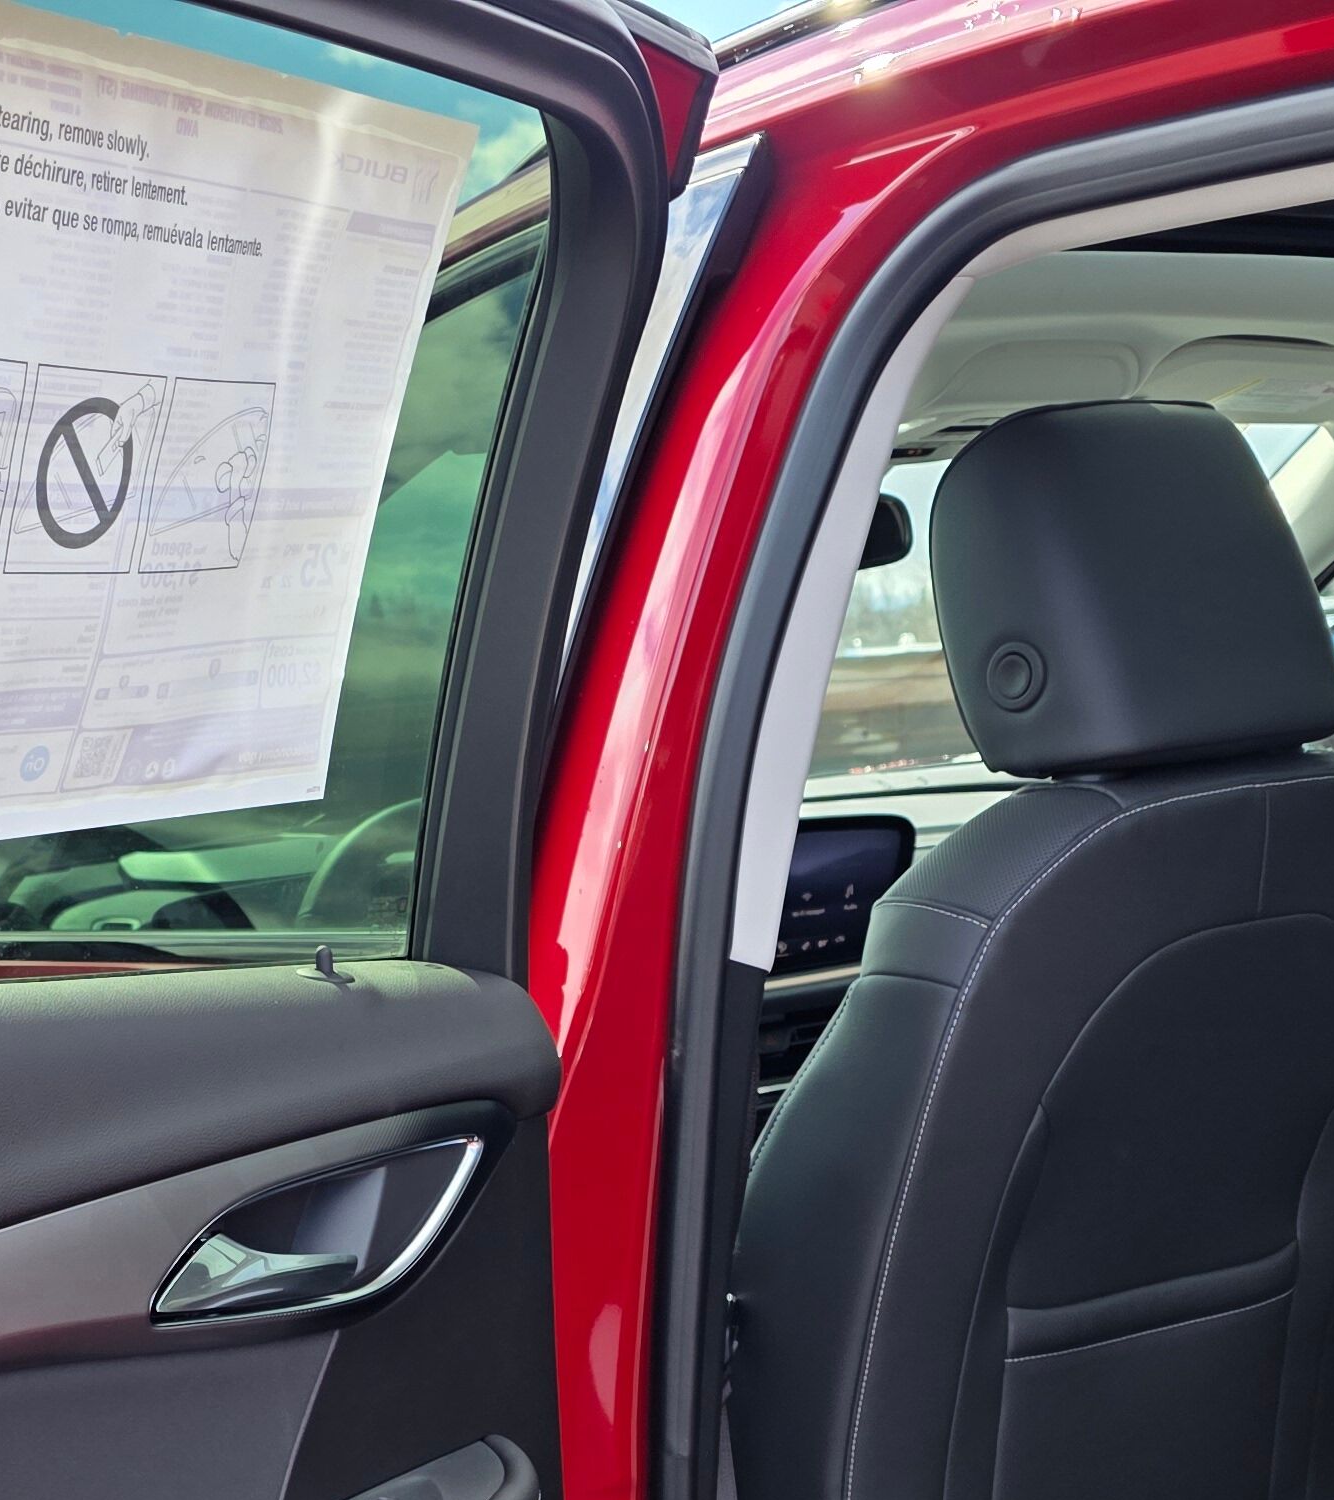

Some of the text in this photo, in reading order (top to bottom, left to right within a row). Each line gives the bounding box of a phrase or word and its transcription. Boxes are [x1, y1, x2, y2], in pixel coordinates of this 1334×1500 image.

[58, 122, 103, 149] remove
[107, 130, 150, 161] slowly.
[14, 153, 87, 192] déchirure,
[91, 170, 128, 195] retirer
[131, 176, 188, 206] lentement.
[4, 197, 49, 223] evitar
[52, 208, 80, 230] que
[83, 213, 98, 232] se
[101, 217, 139, 242] rompa,
[142, 223, 203, 249] remuévala
[206, 230, 263, 257] lentamente.
